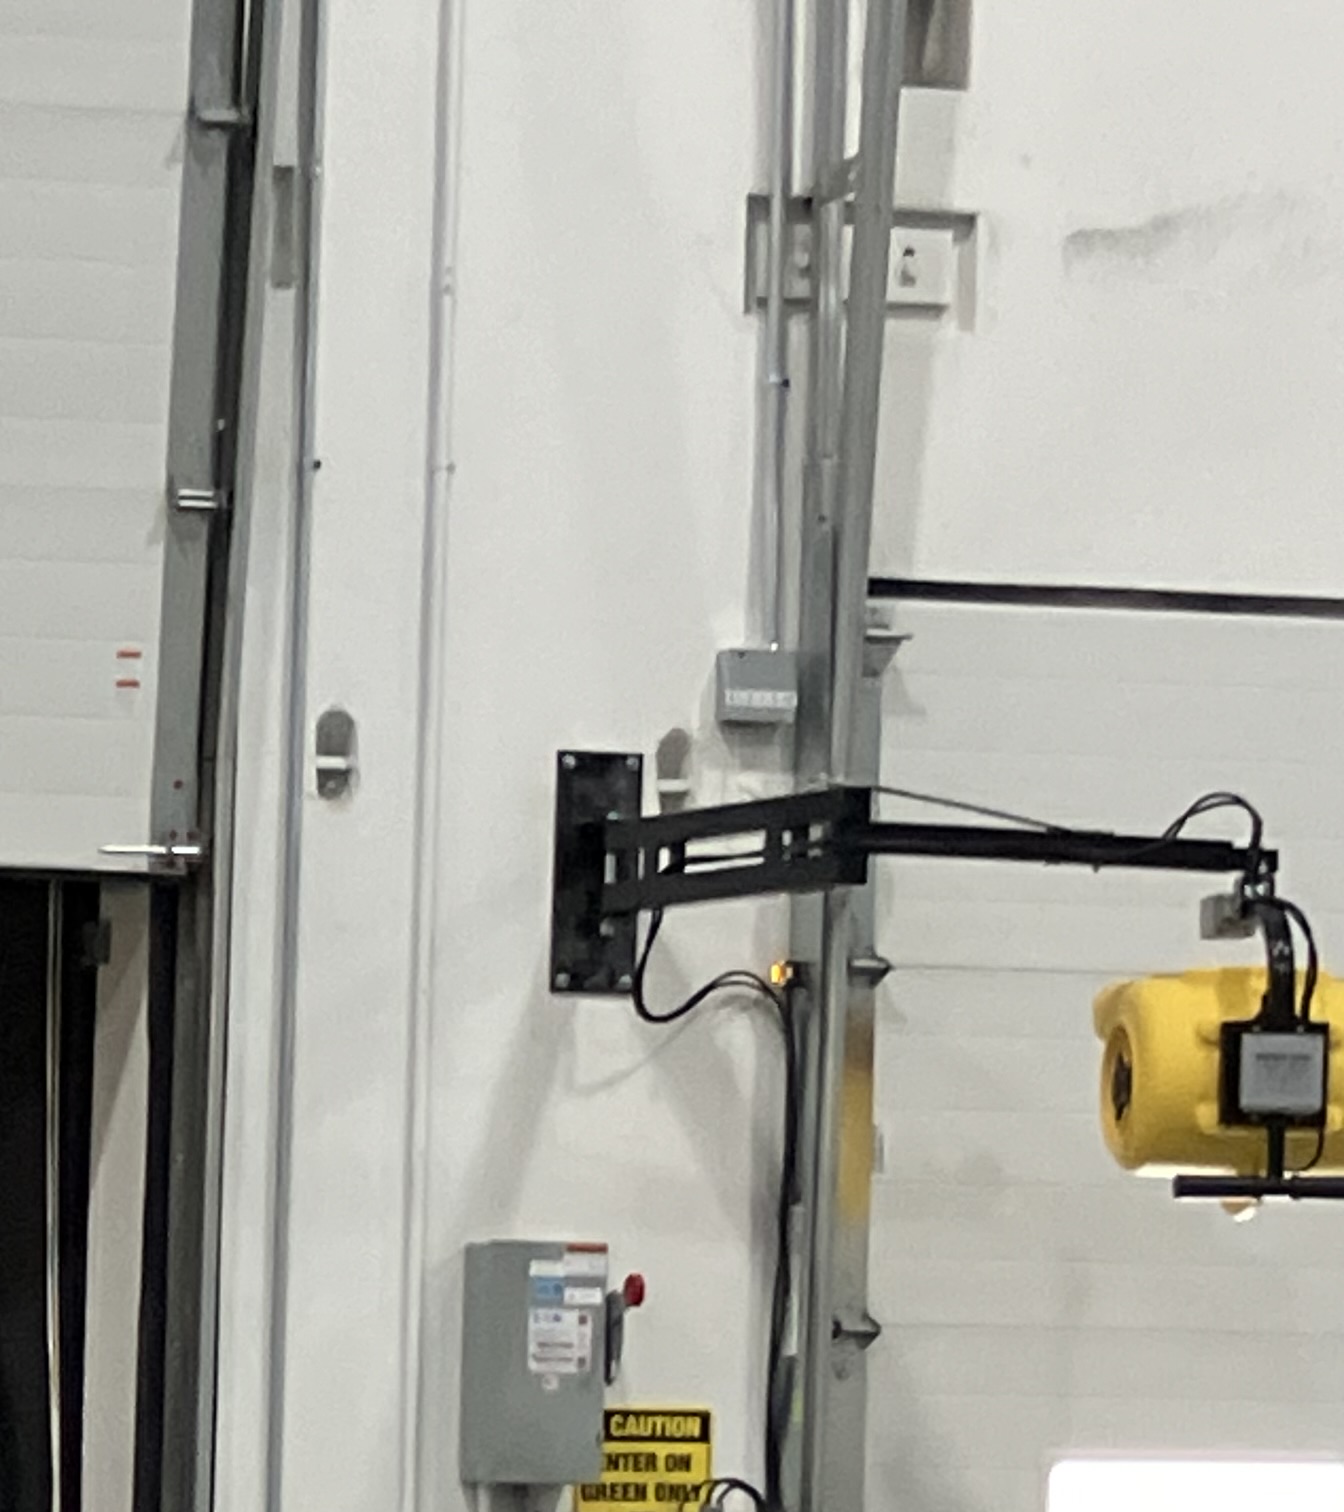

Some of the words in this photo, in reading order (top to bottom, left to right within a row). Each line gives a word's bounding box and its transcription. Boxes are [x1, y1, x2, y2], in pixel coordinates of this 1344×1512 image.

[610, 1413, 702, 1438] CAUTION
[602, 1452, 658, 1473] NTER
[665, 1453, 692, 1473] ON
